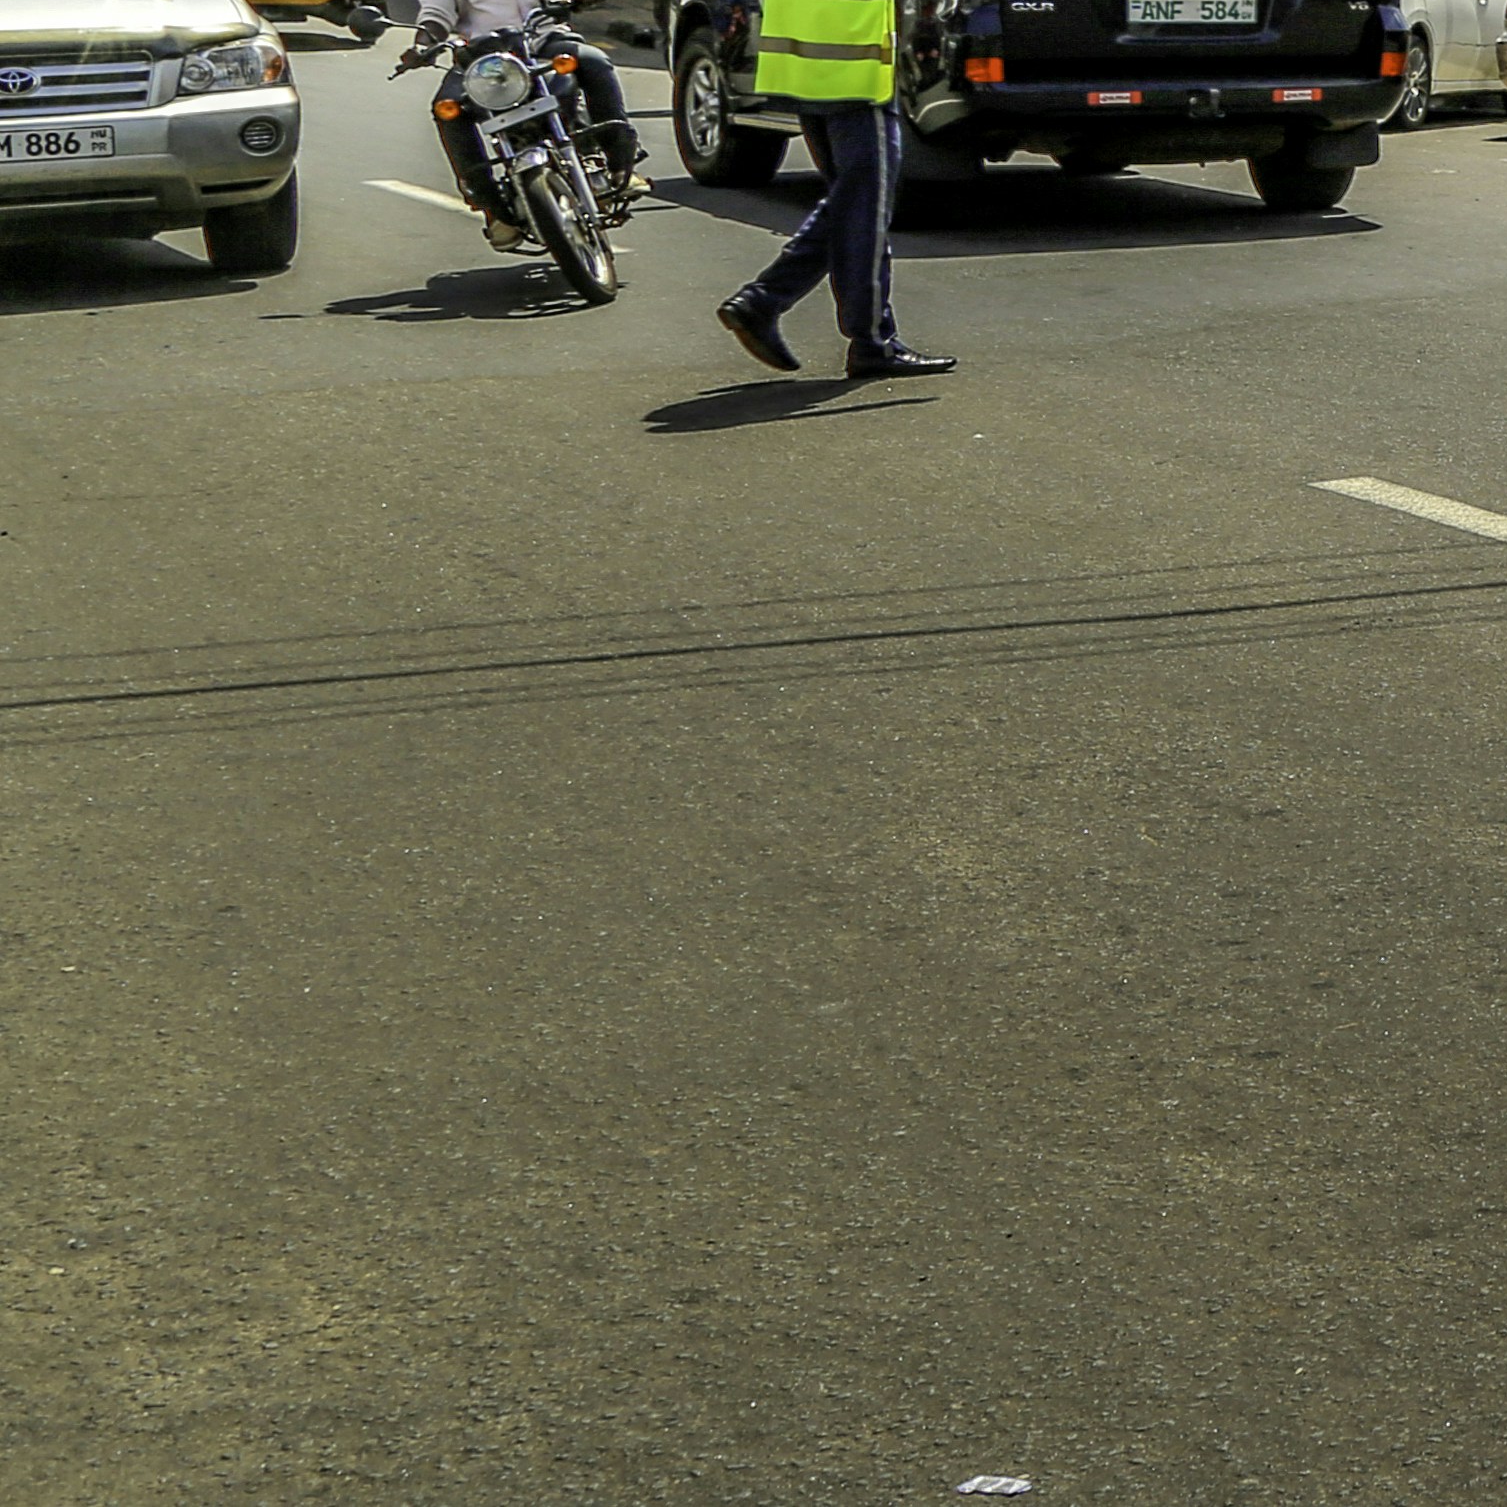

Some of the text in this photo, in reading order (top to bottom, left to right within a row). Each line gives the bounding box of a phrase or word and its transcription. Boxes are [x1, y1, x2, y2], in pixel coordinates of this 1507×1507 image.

[1140, 0, 1240, 21] ANF 584
[25, 132, 82, 157] 886
